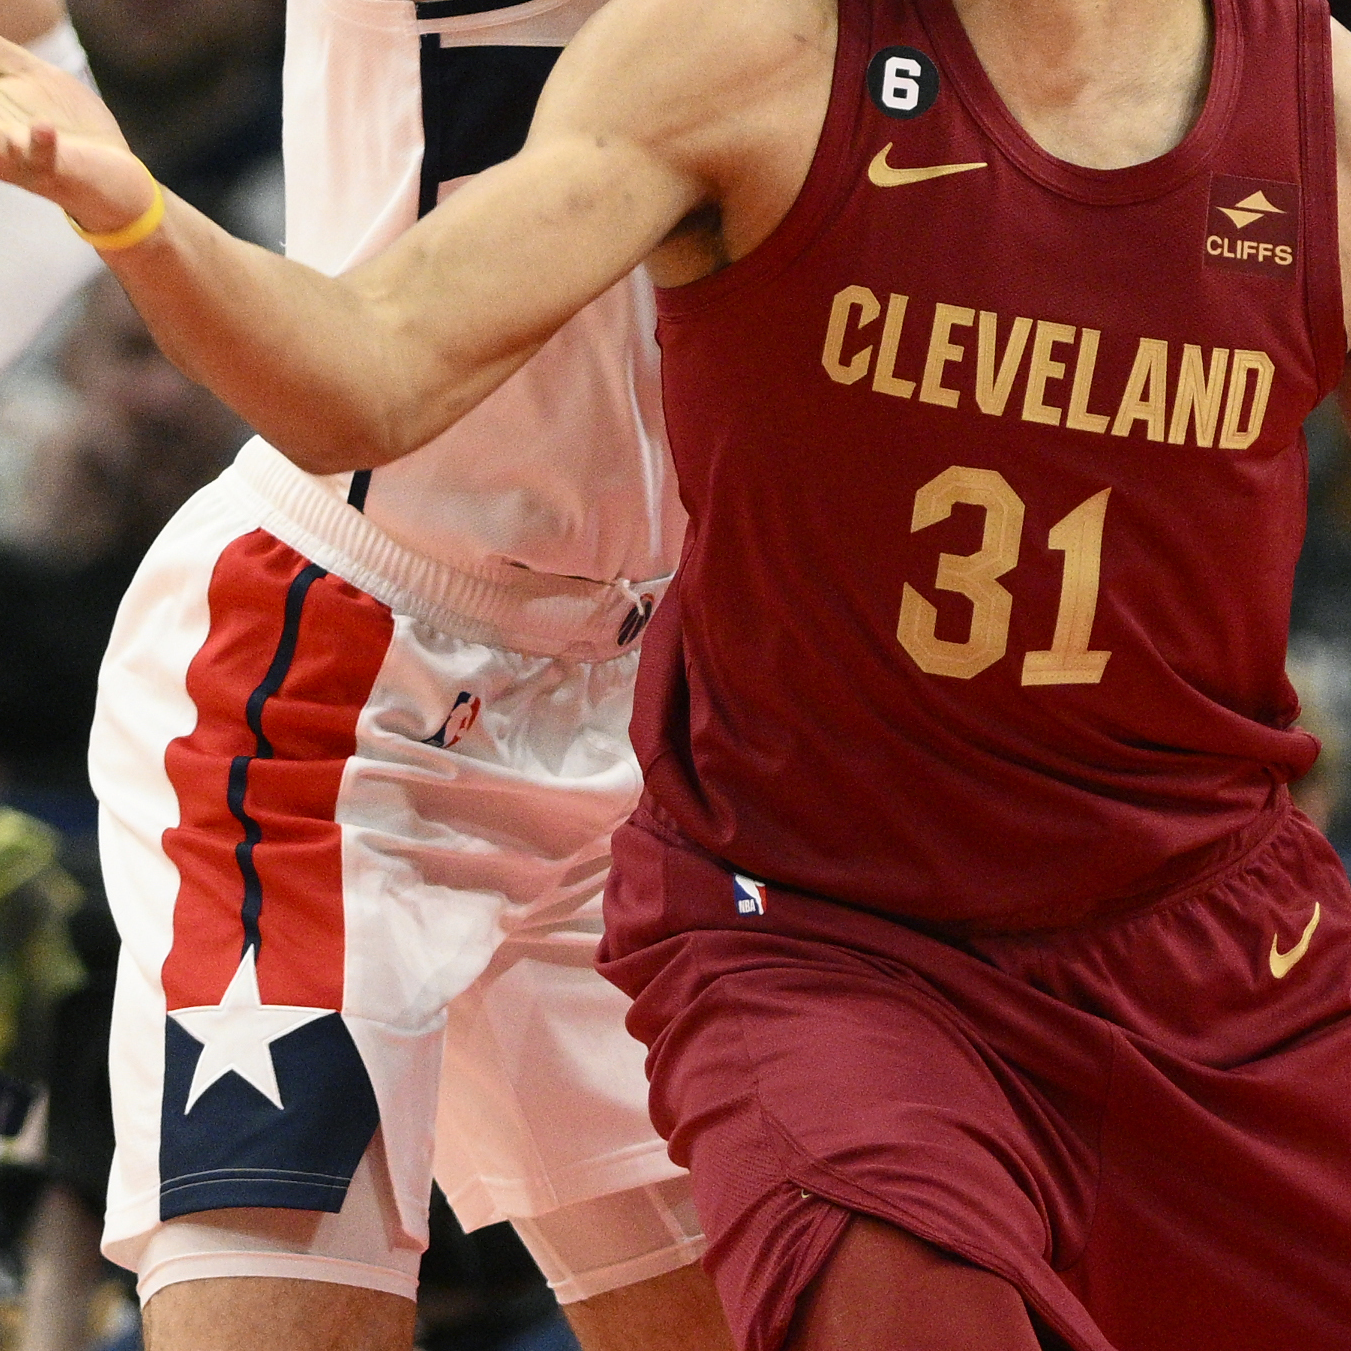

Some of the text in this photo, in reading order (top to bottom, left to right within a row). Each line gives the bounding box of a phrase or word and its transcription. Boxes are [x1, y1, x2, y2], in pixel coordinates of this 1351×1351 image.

[882, 56, 922, 111] 6
[1206, 235, 1293, 266] CLIFFS
[821, 284, 1275, 450] CLEVELAND
[896, 465, 1113, 686] 31
[738, 899, 757, 914] NBA
